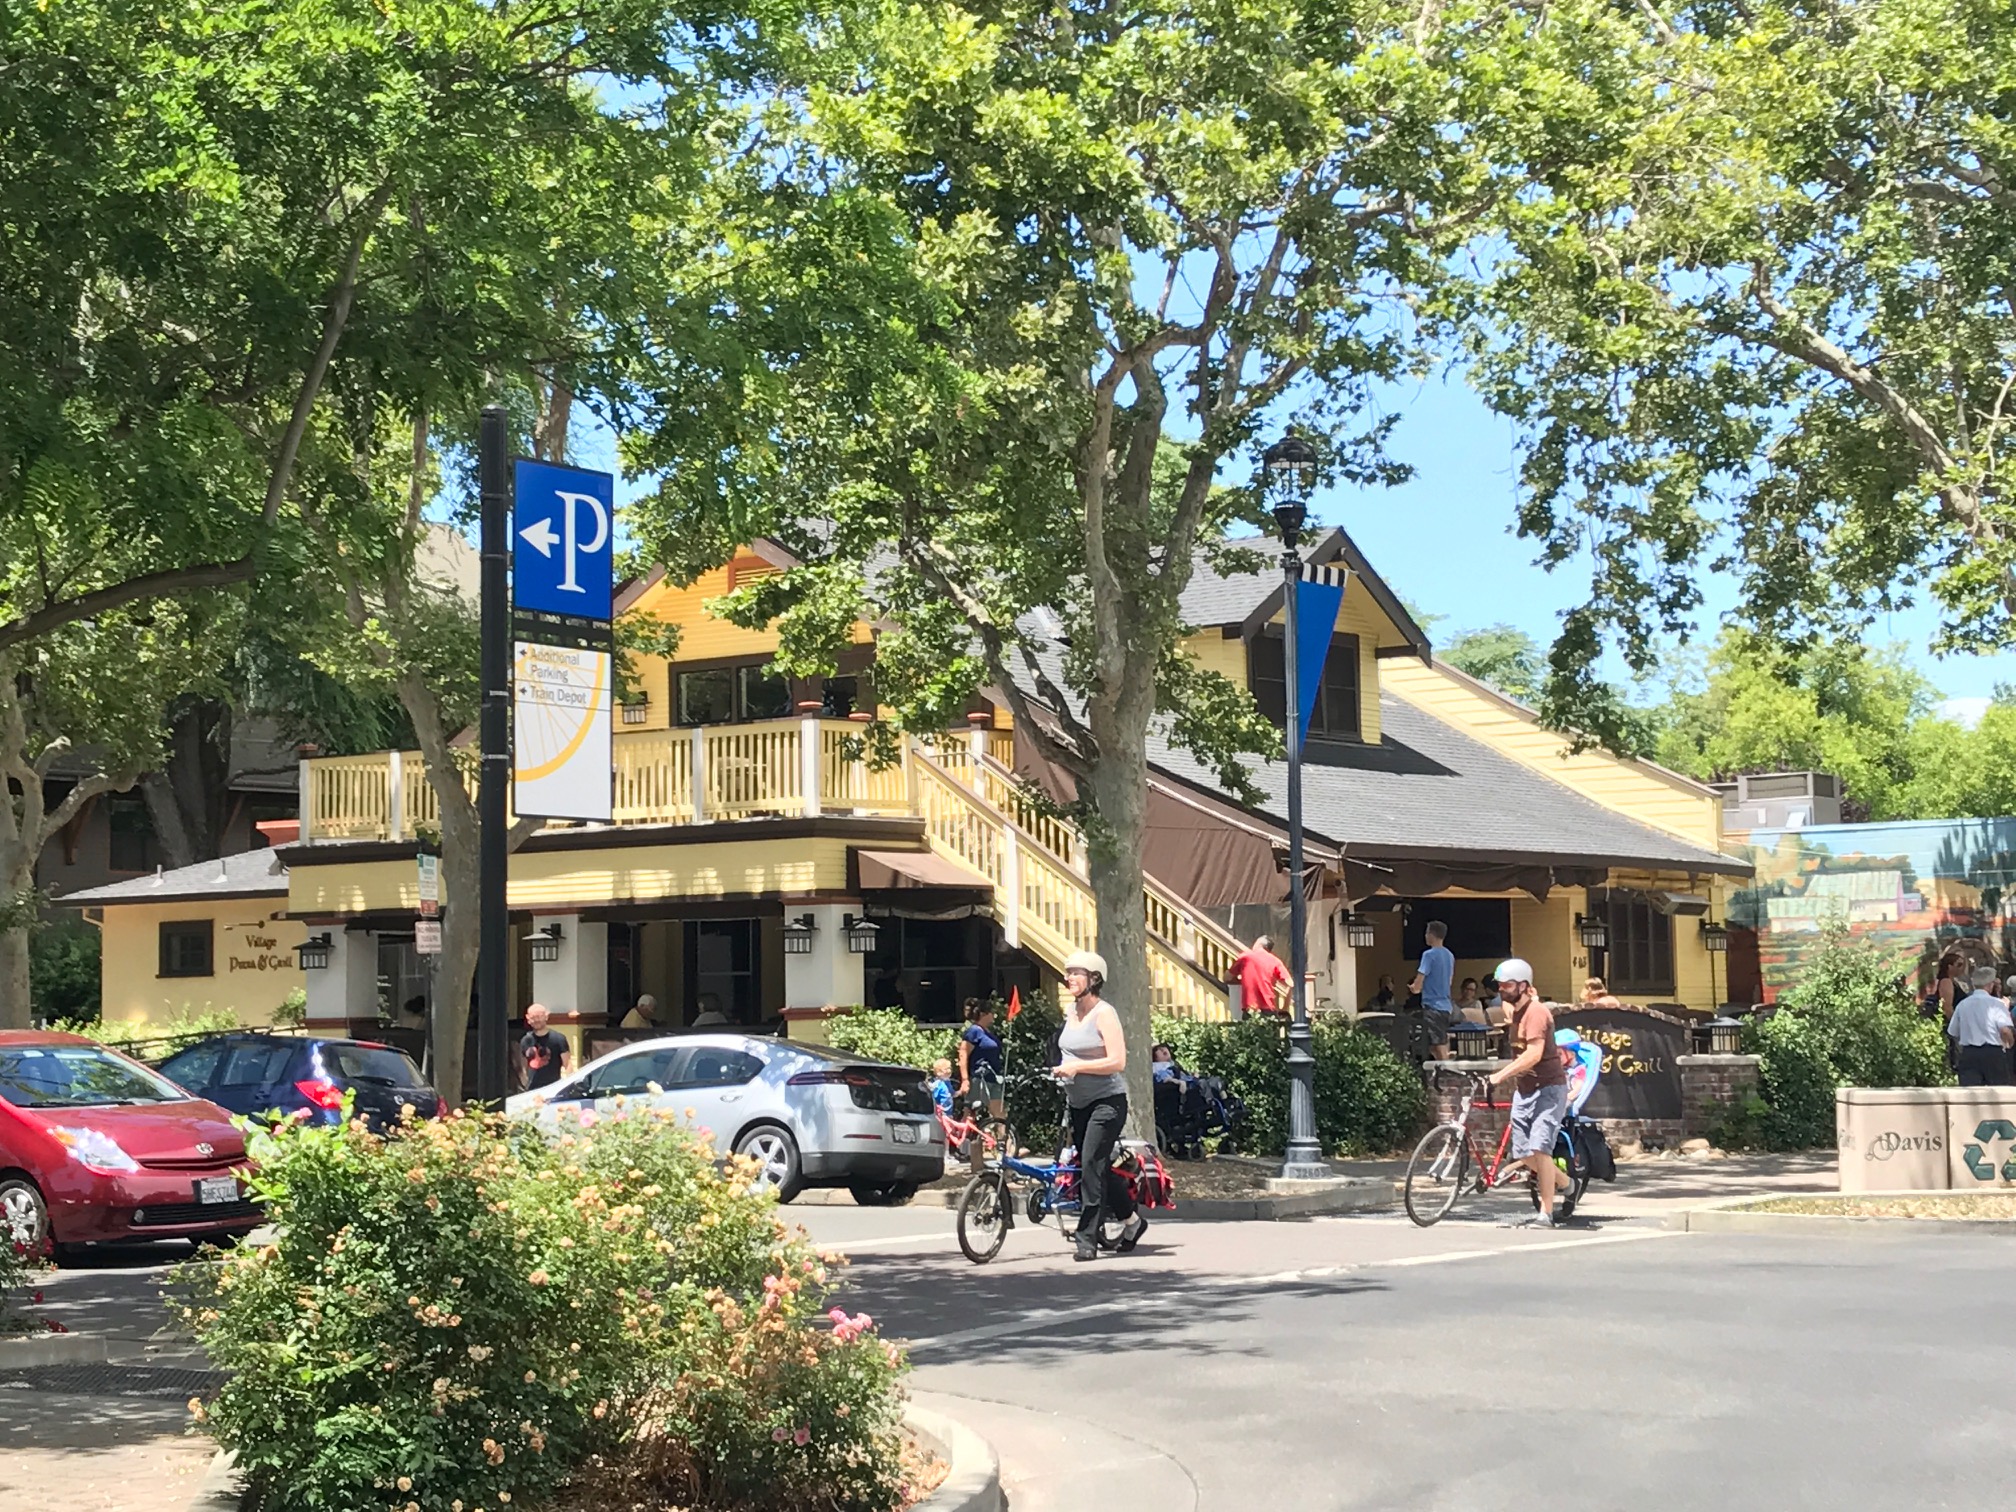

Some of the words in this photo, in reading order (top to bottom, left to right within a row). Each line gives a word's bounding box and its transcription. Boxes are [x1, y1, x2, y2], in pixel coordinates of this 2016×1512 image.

[555, 489, 608, 594] P
[530, 648, 580, 665] Additional
[531, 664, 568, 683] Parking
[530, 685, 555, 701] Train
[557, 688, 587, 705] Depot
[245, 934, 277, 950] Village
[1884, 1131, 1943, 1151] Davis
